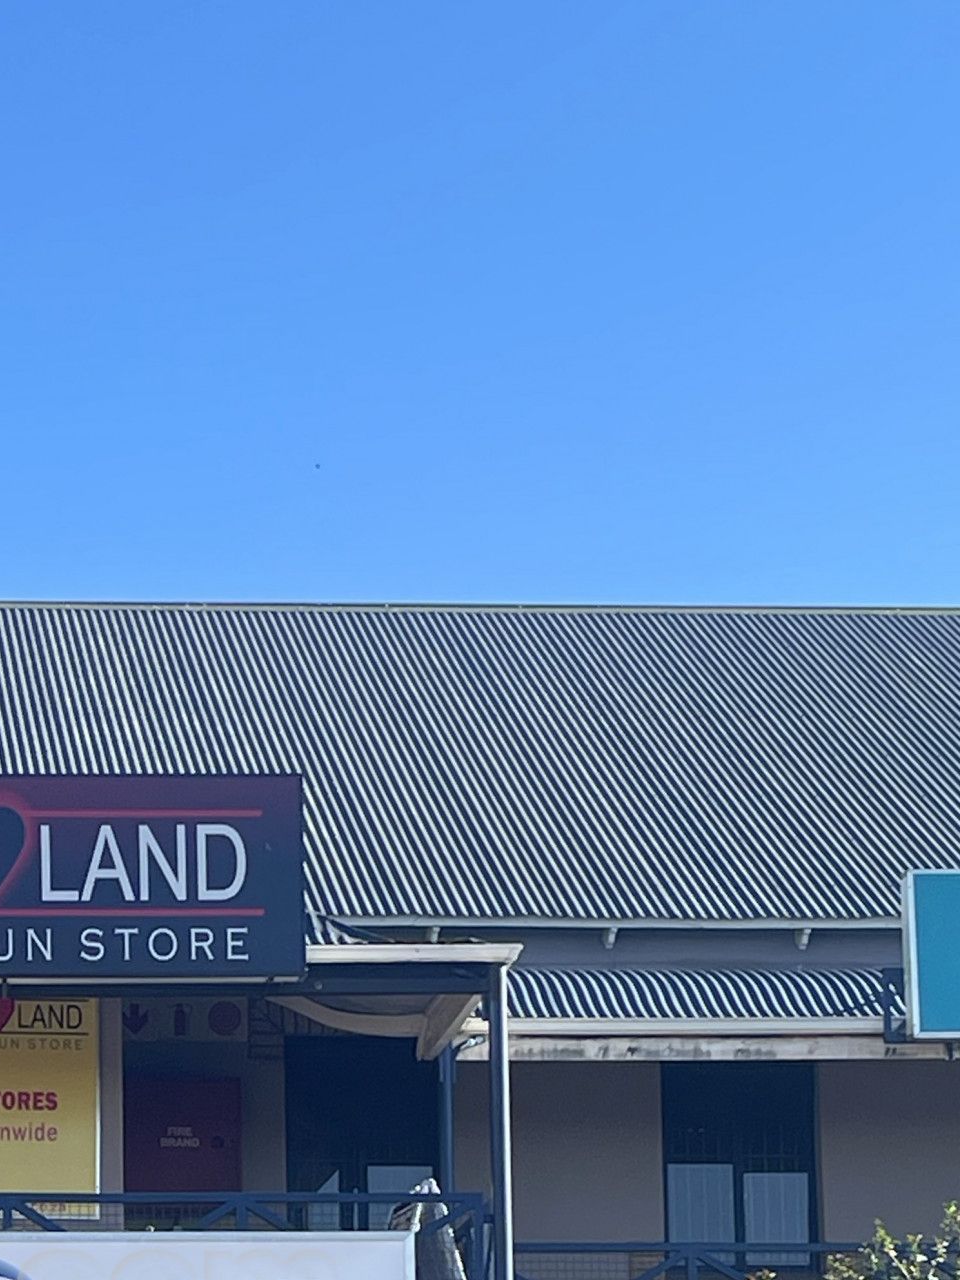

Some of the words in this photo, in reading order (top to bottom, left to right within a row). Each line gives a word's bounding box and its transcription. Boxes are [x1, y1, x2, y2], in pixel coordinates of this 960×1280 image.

[40, 823, 248, 902] LAND
[80, 927, 250, 962] STORE
[17, 1004, 83, 1030] LAND
[26, 1038, 83, 1051] STORE
